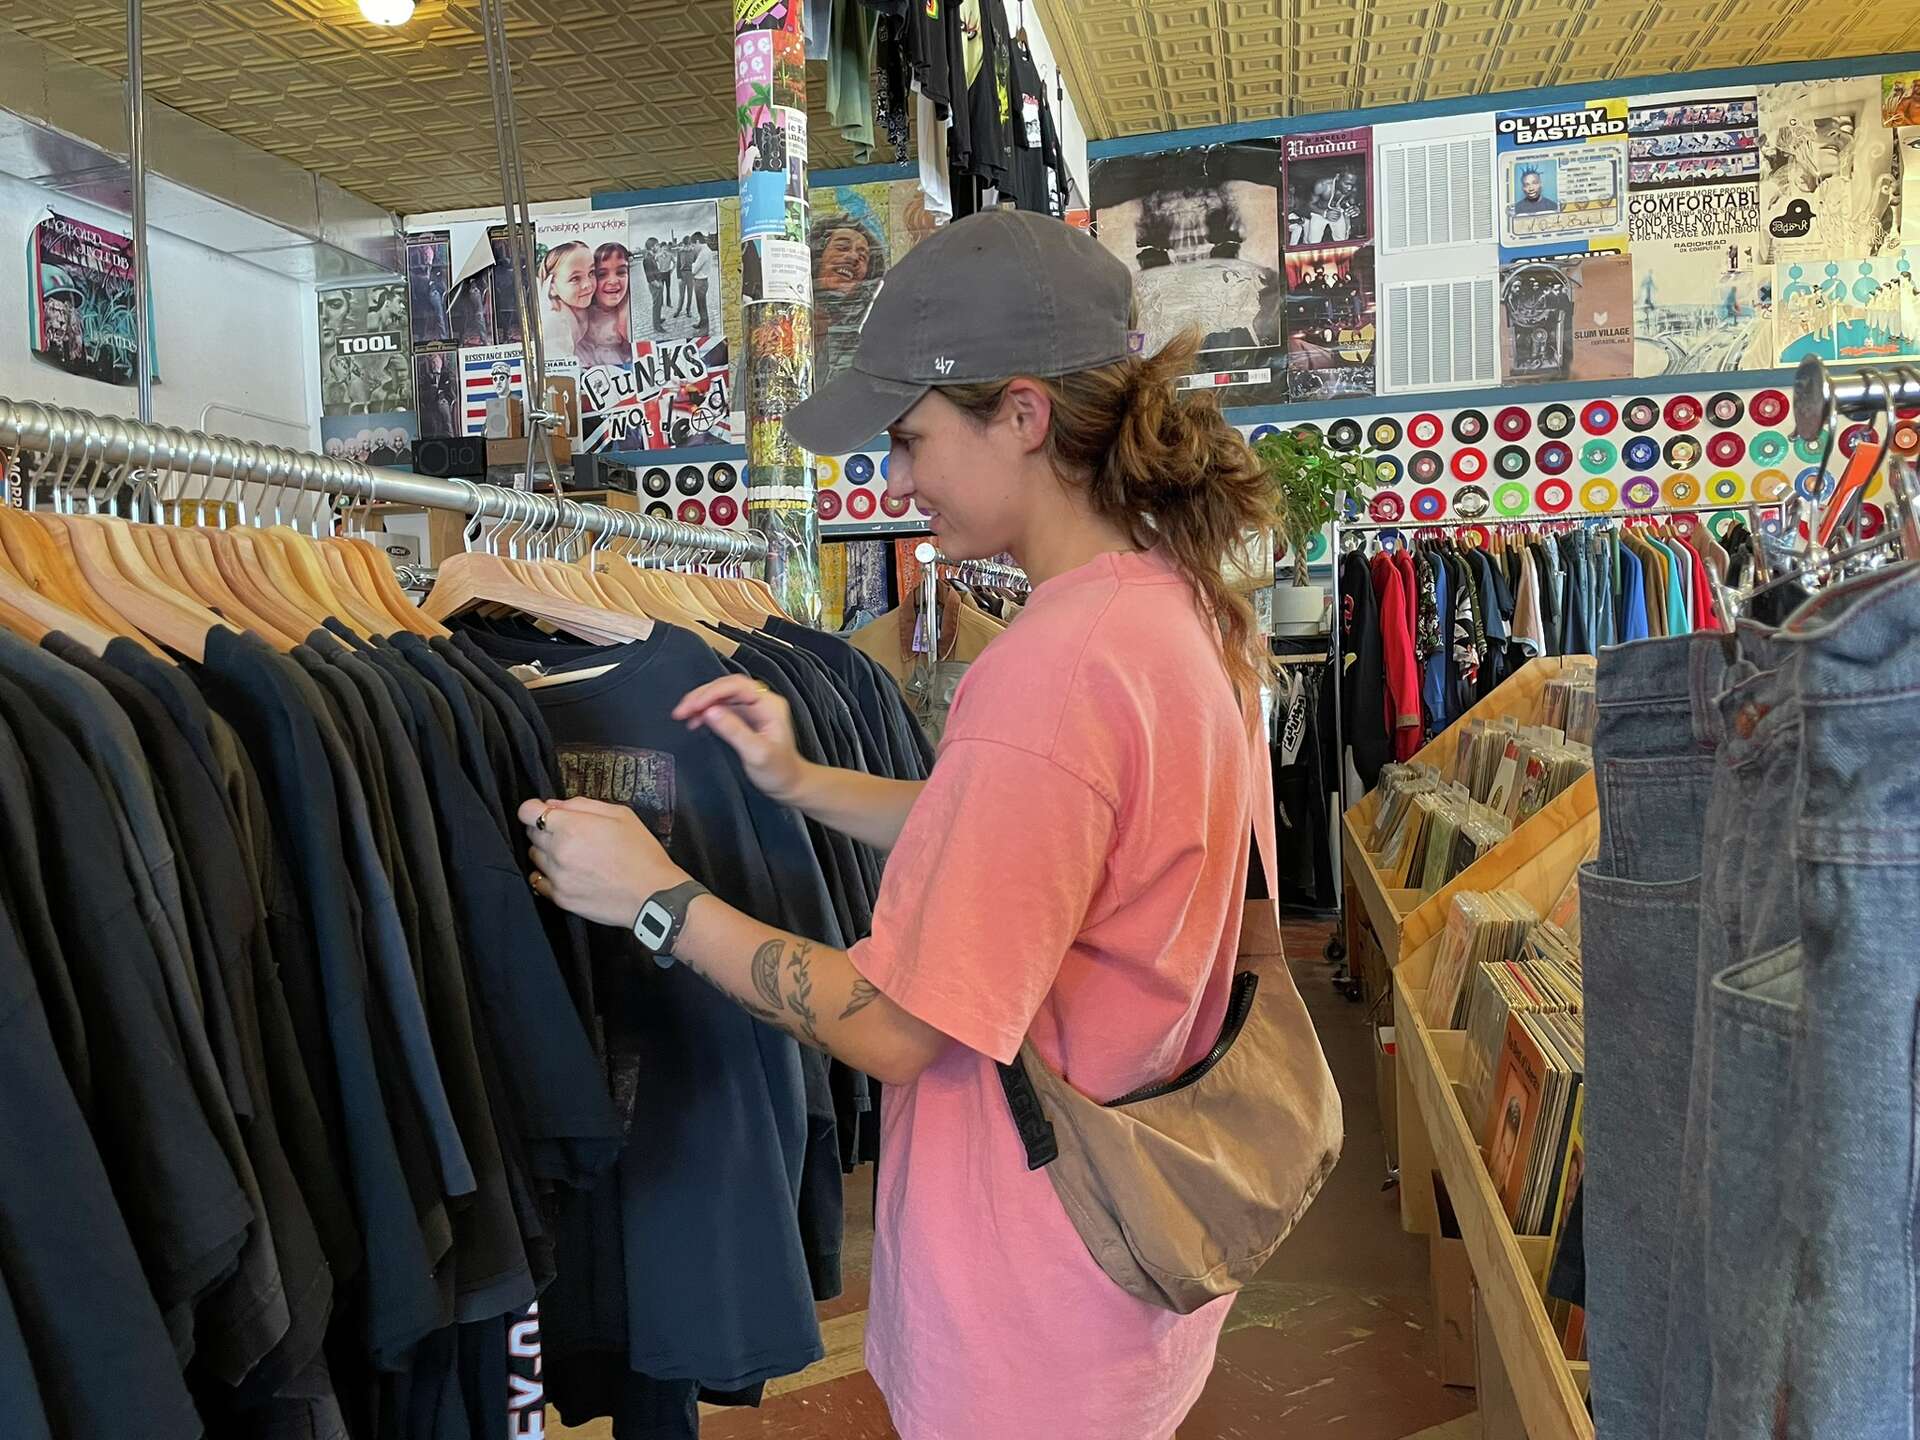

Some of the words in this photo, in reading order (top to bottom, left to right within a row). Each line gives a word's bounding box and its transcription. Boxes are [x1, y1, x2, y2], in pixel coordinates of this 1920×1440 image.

[1516, 120, 1625, 144] BASTARD
[1657, 190, 1691, 199] HAPPIER
[1694, 188, 1718, 196] MORE
[1695, 212, 1719, 224] NOT
[1724, 210, 1736, 221] IN
[1741, 208, 1760, 220] LO
[1674, 230, 1699, 238] CAGE
[1673, 239, 1727, 249] RADIOHEAD
[1689, 245, 1721, 253] COMPUTER
[1574, 330, 1597, 339] SLUM
[1599, 327, 1631, 337] VILLAGE
[338, 335, 398, 354] TOOL
